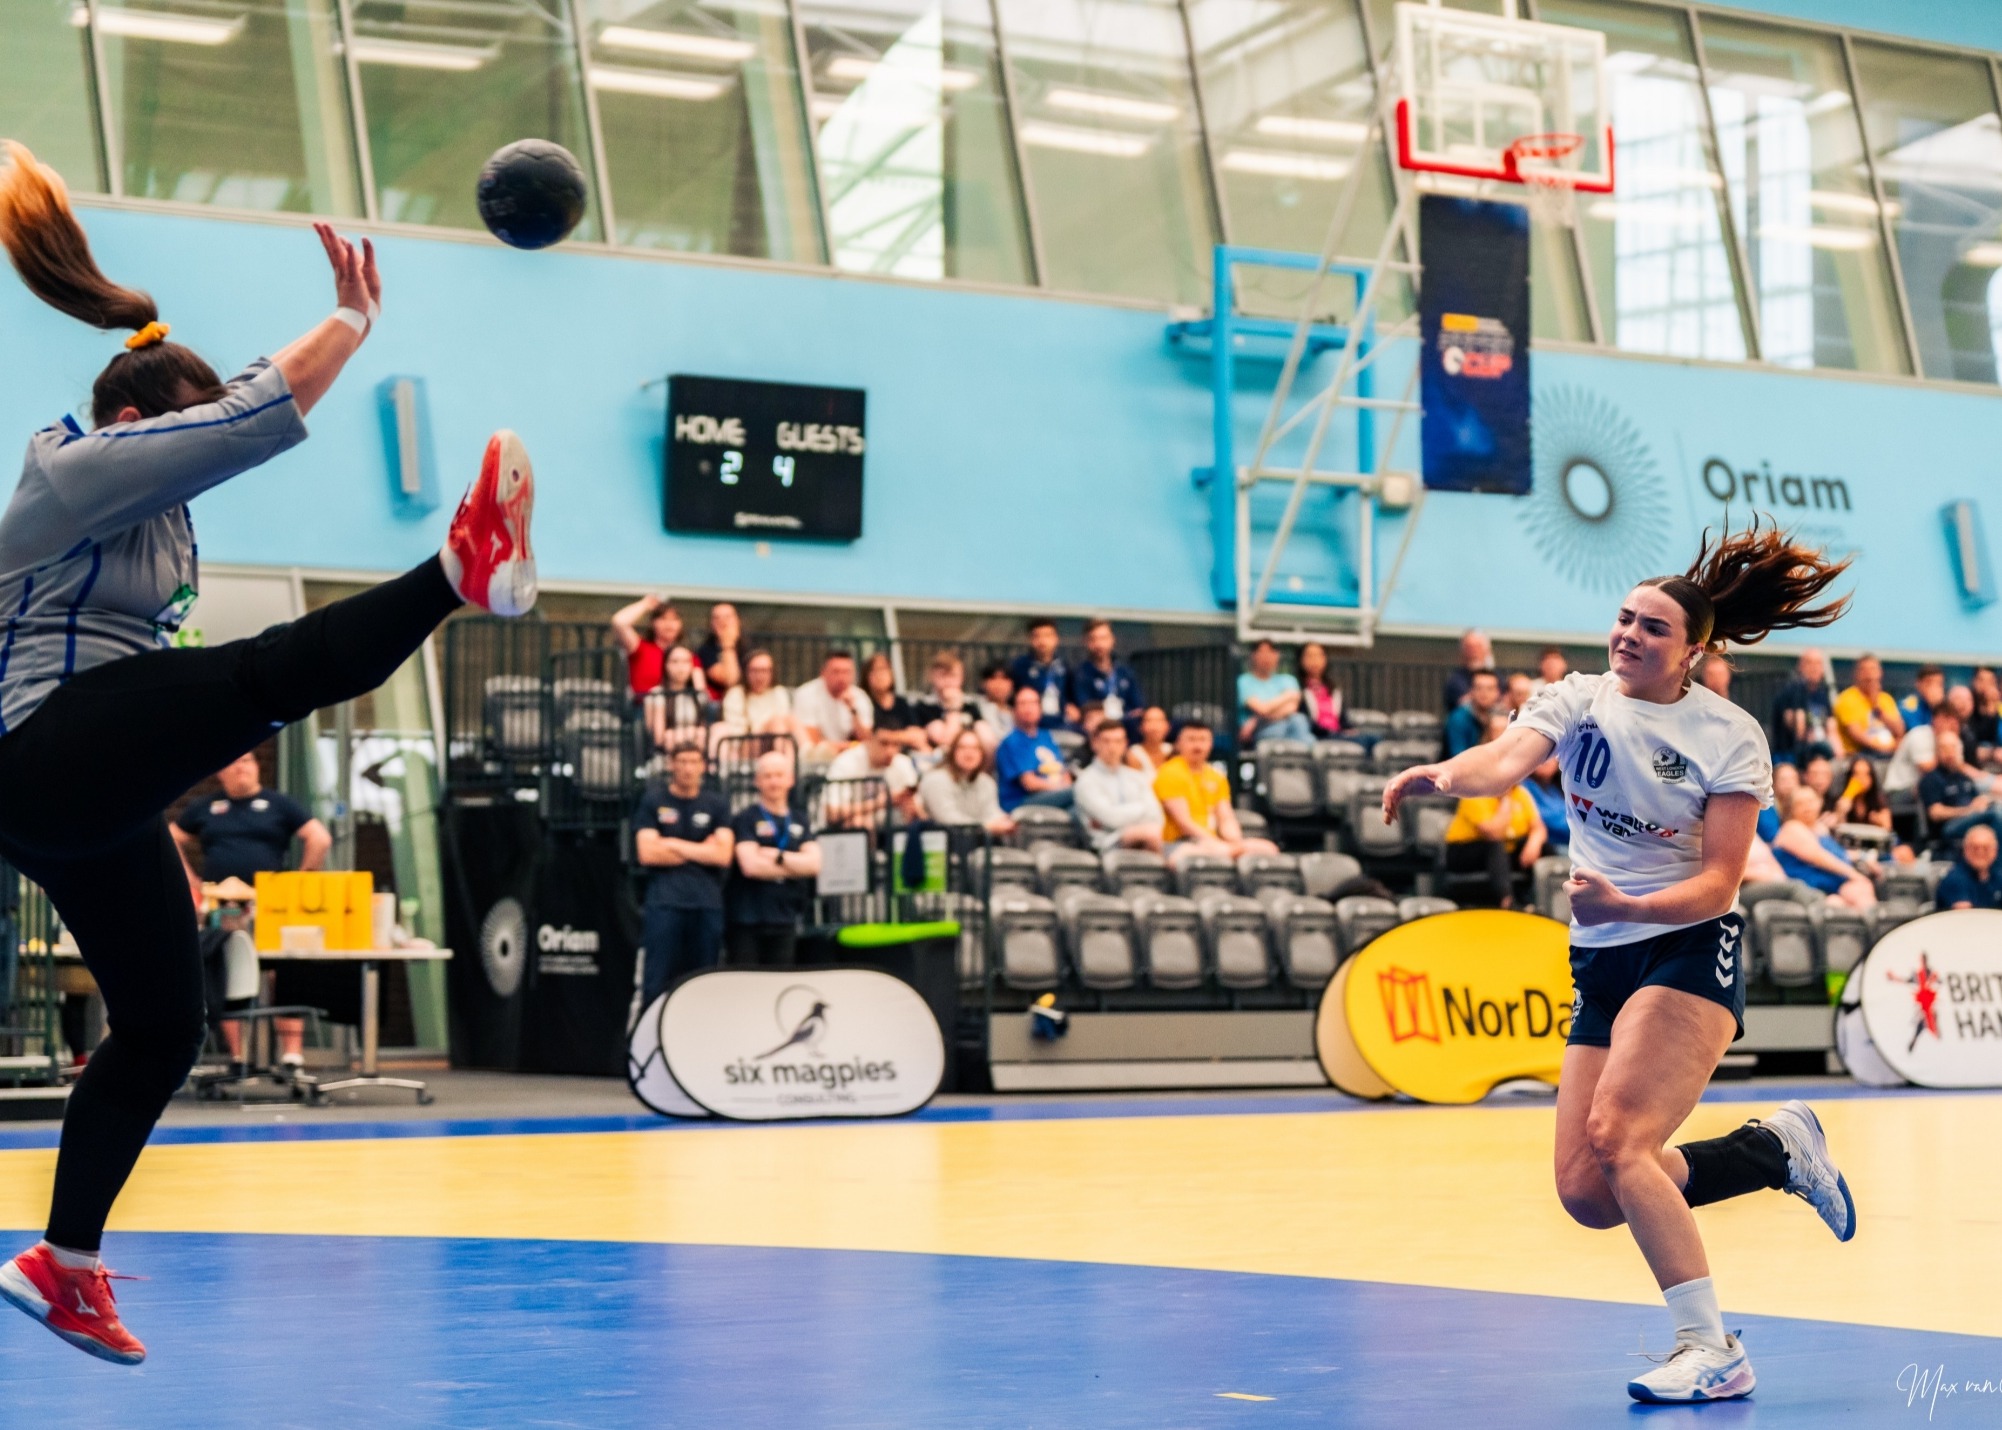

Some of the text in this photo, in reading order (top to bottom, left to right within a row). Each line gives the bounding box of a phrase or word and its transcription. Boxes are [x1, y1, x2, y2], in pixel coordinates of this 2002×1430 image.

[675, 415, 865, 455] HOME GUESTS
[720, 451, 795, 487] 2 4
[1702, 457, 1853, 511] Oriam
[1574, 732, 1611, 789] 10
[538, 924, 600, 952] Oriam
[724, 1057, 896, 1092] six magpies
